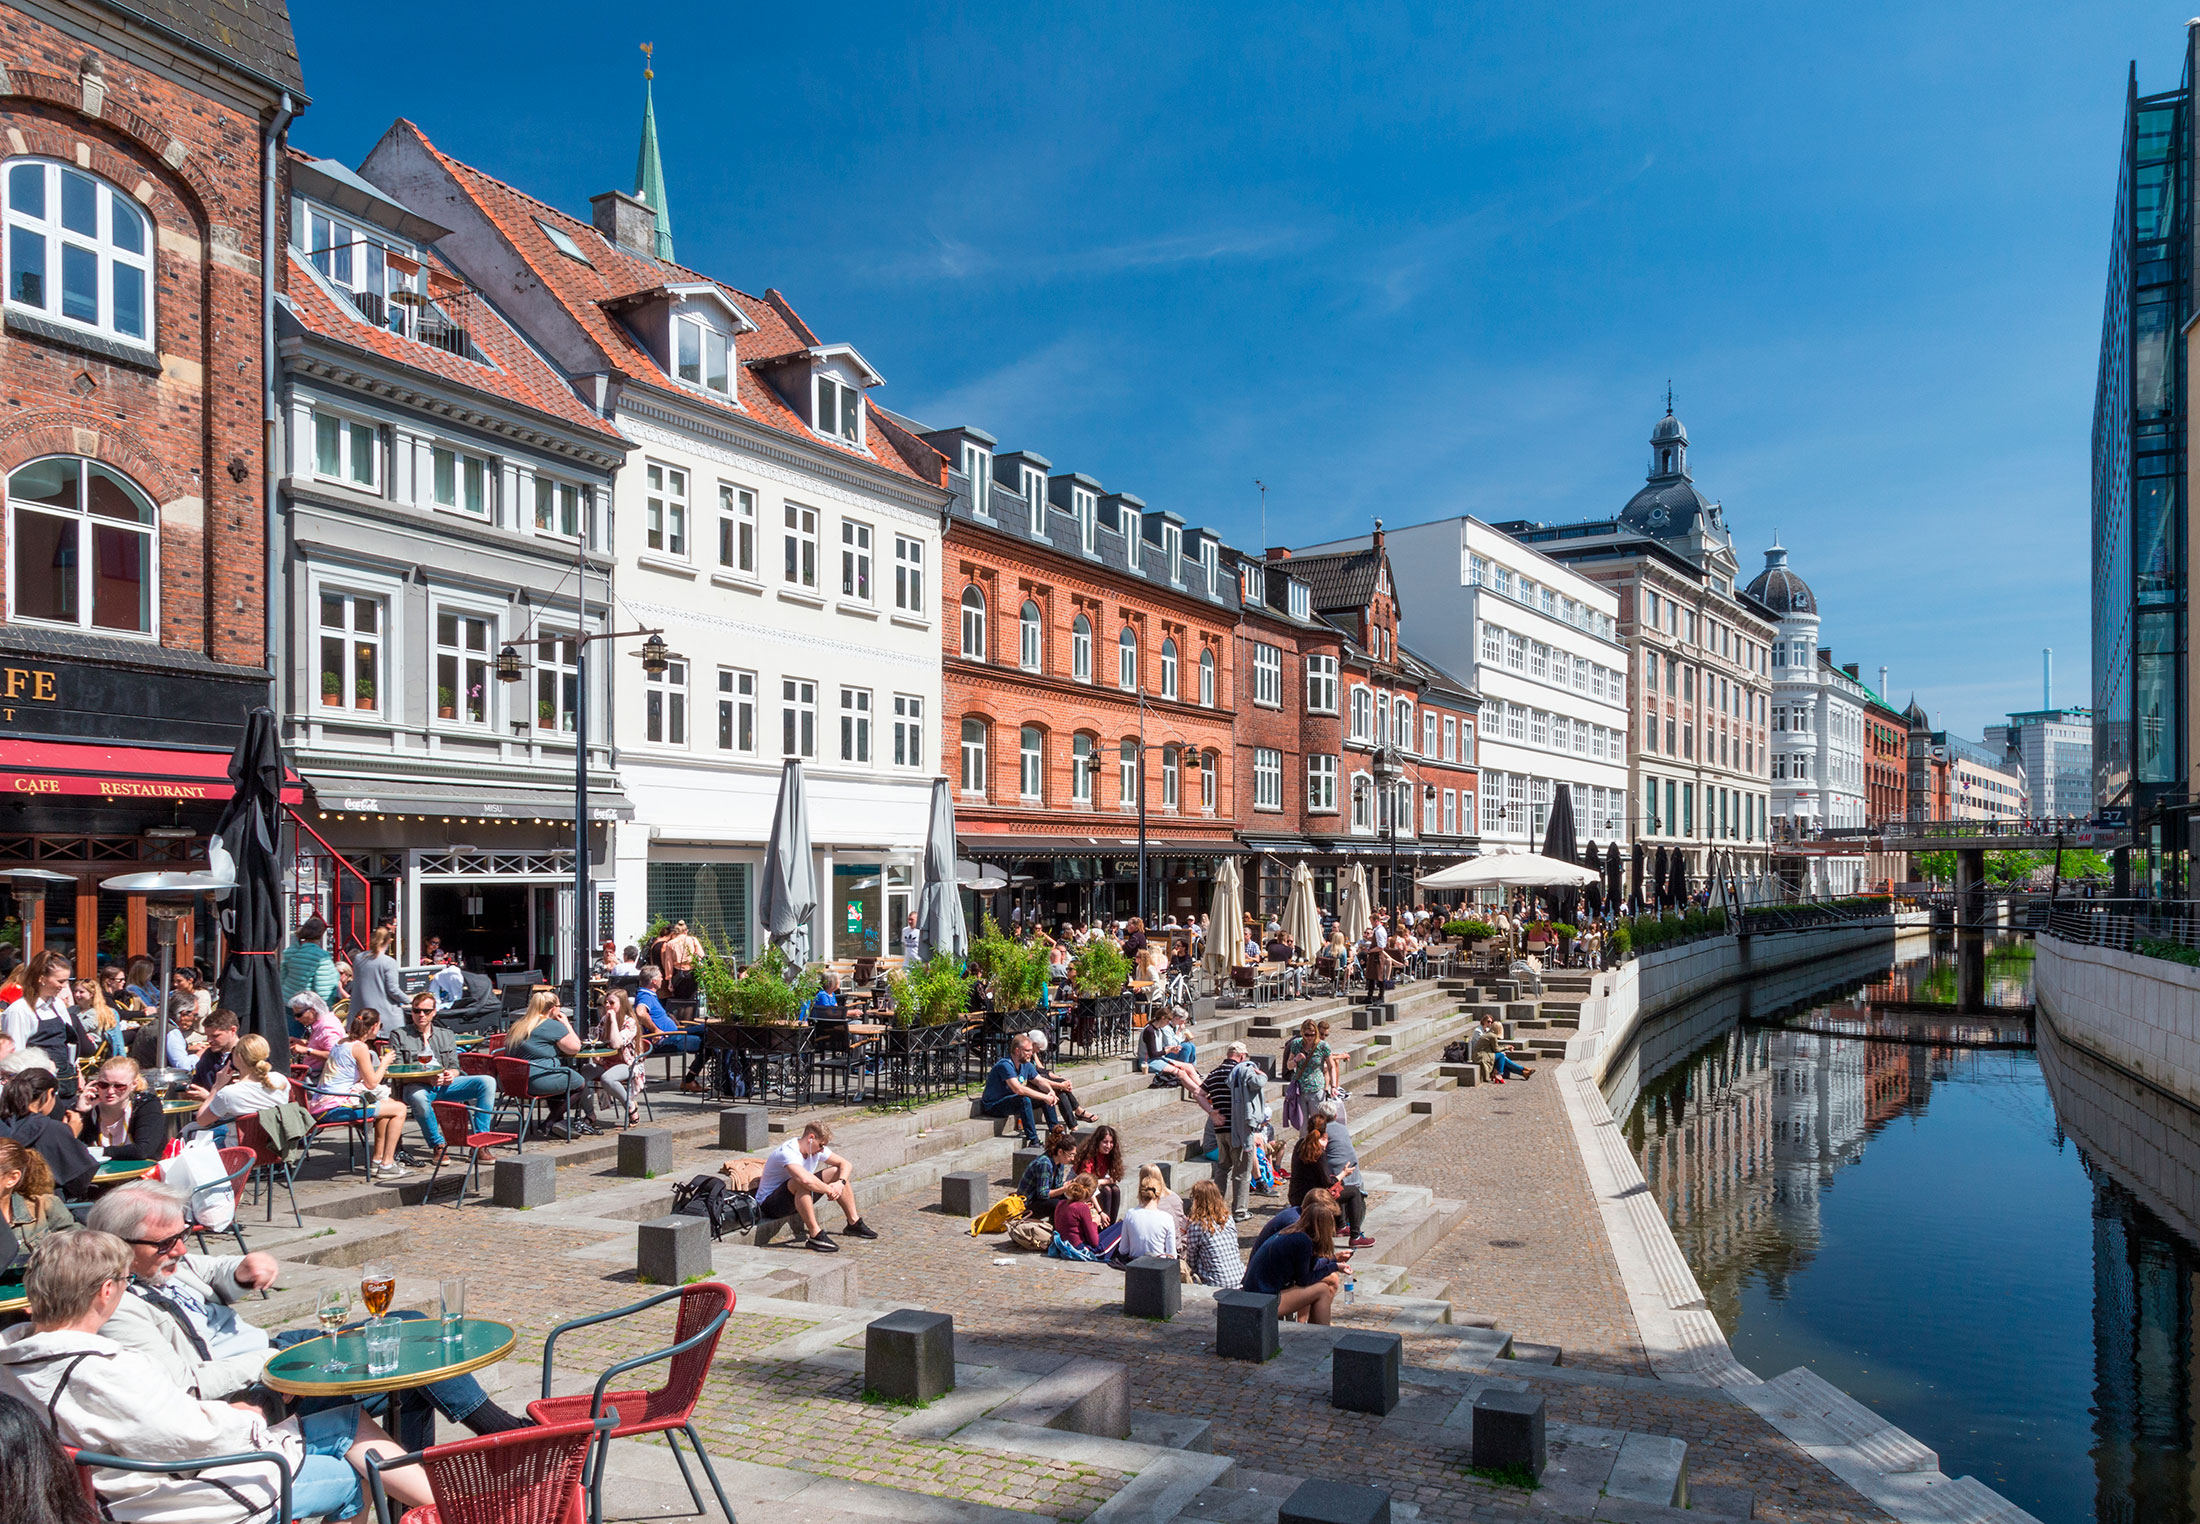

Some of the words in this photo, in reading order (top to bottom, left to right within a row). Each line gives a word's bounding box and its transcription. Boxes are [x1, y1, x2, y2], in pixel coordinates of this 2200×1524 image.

[0, 667, 56, 701] FE
[15, 778, 60, 792] CAFE
[99, 782, 206, 798] RESTAURANT
[483, 804, 503, 813] MISU
